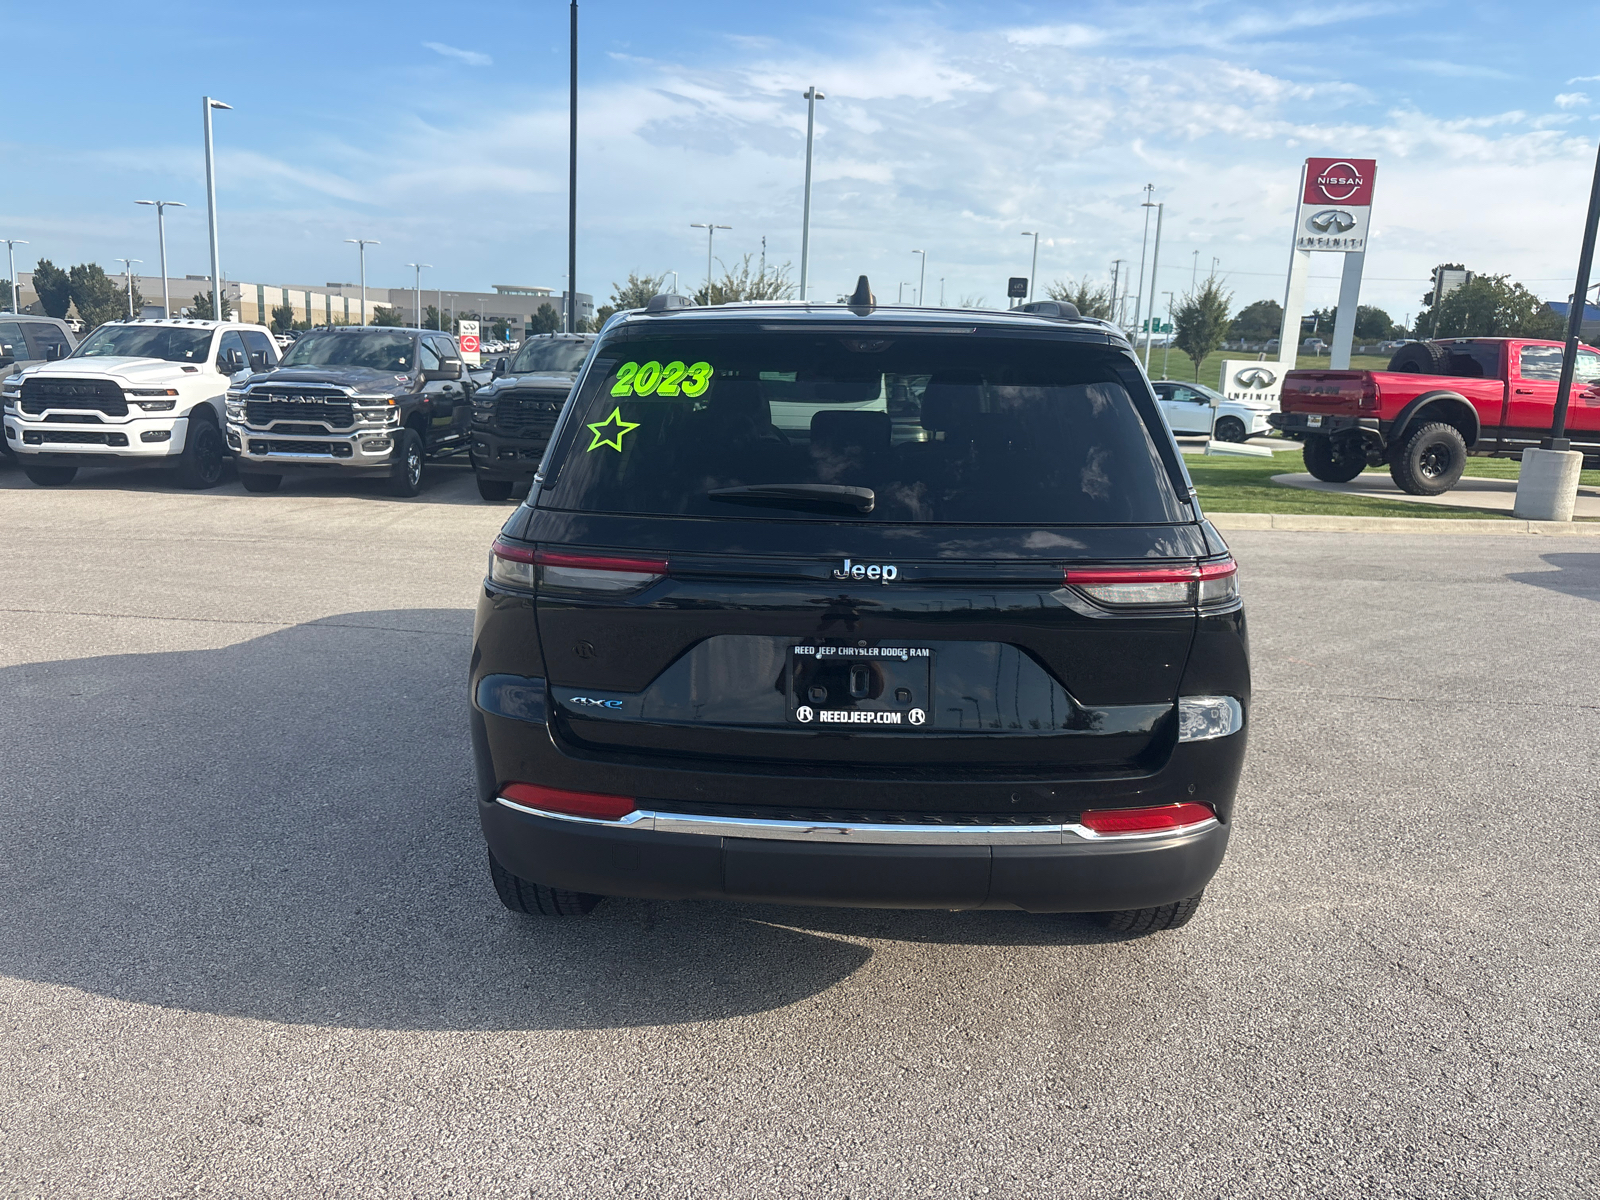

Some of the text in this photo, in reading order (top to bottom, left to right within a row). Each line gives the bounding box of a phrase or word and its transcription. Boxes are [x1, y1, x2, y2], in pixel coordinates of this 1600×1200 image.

[1317, 177, 1364, 186] NISSAN
[1300, 237, 1363, 247] INFINITI
[610, 360, 714, 398] 2023
[272, 394, 323, 404] RAM
[833, 558, 898, 585] Jeep
[794, 645, 930, 657] REED JEEP CHRYSLER DODGE RAM
[819, 710, 901, 724] REEDJEEP.COM
